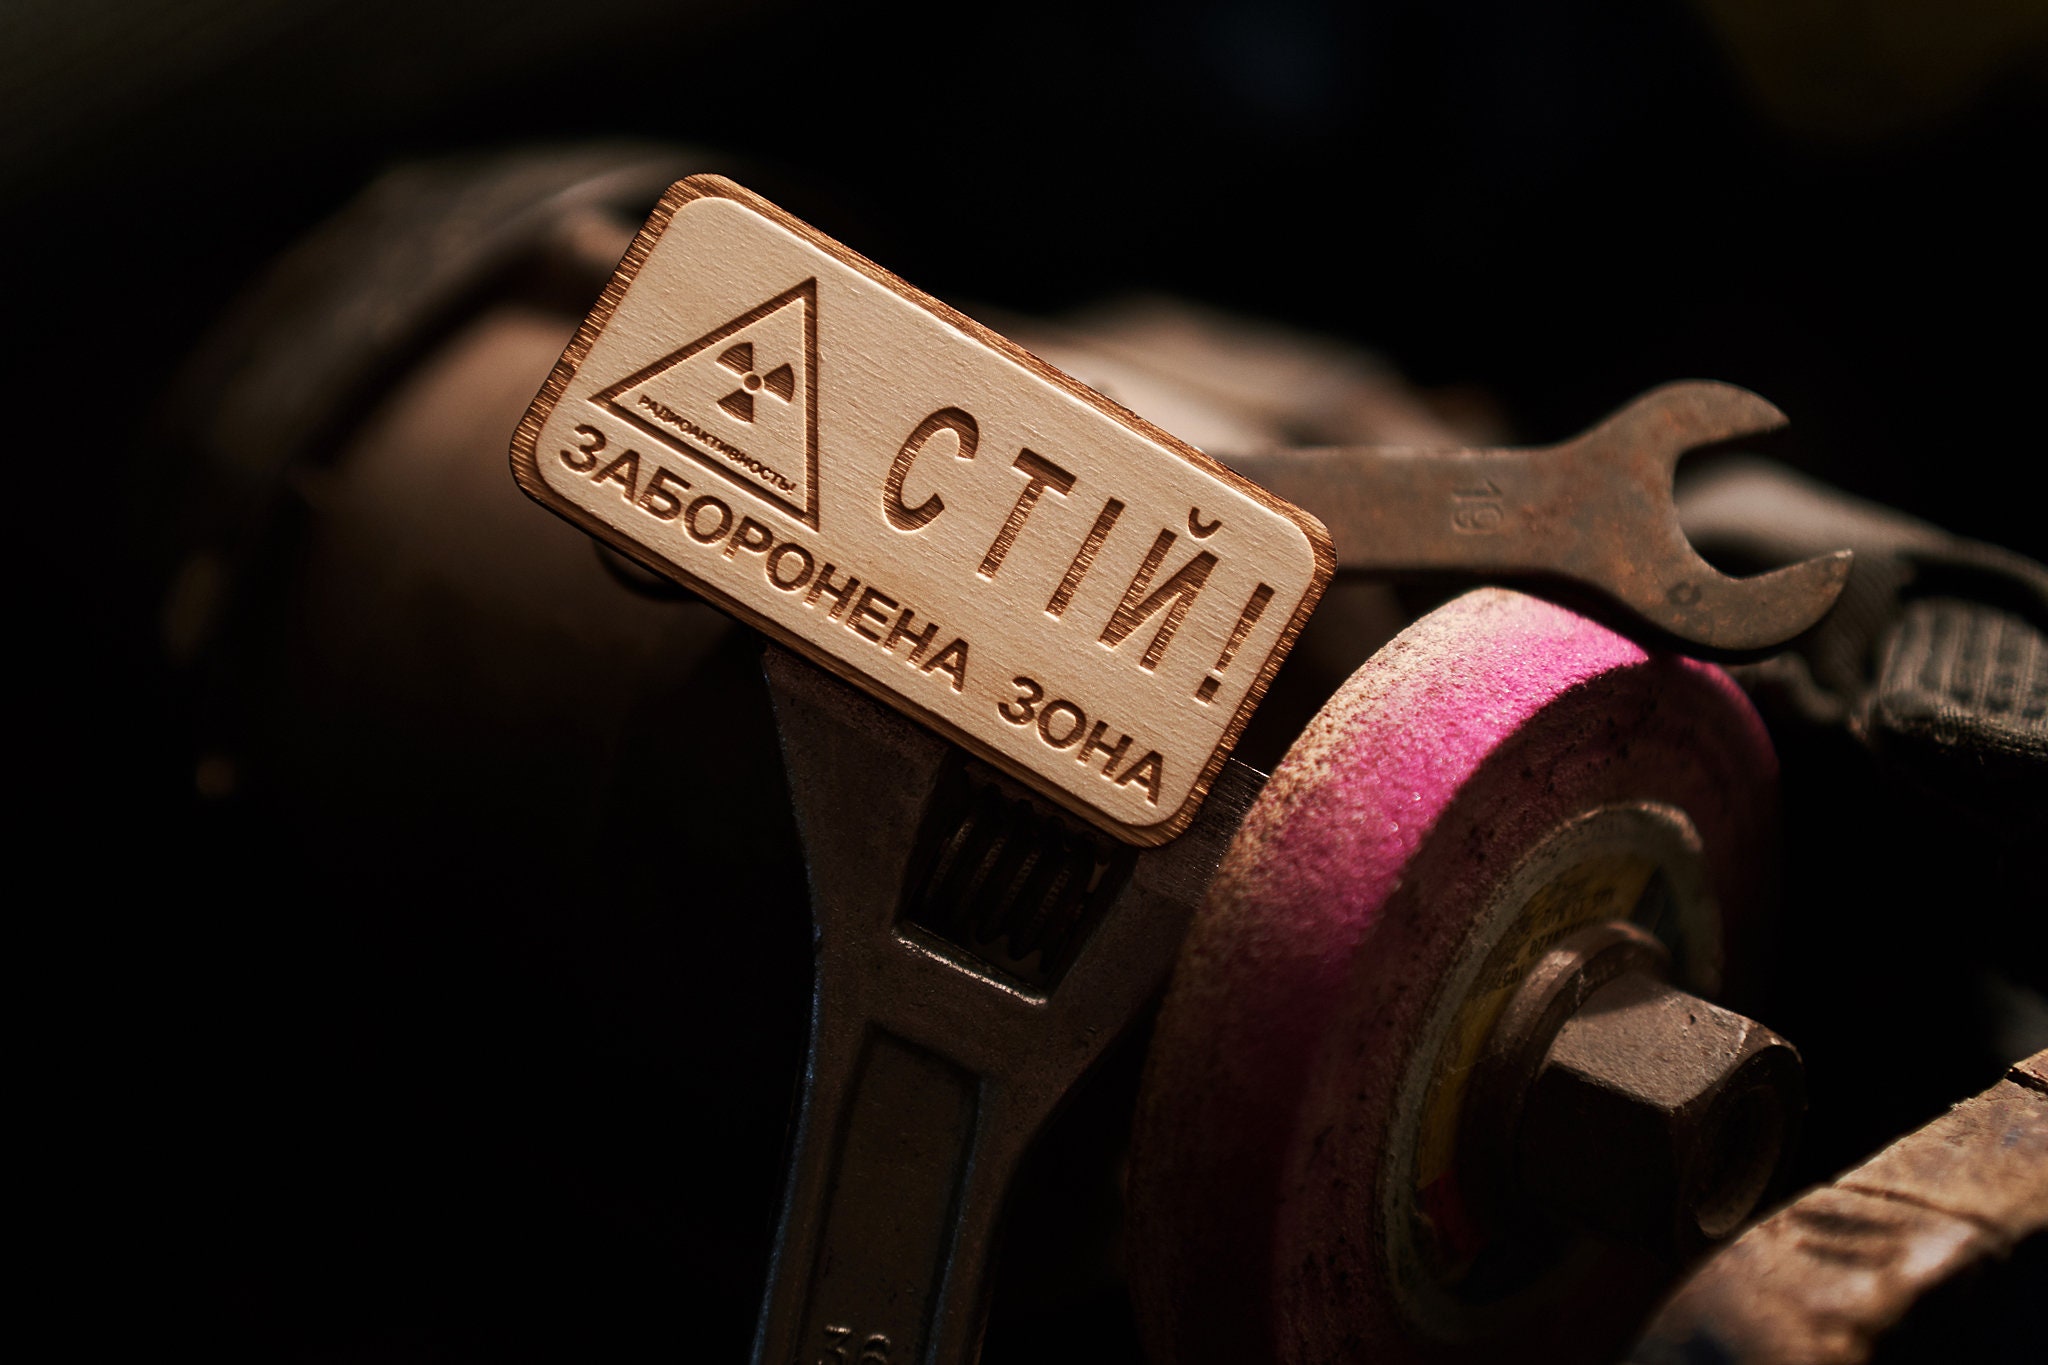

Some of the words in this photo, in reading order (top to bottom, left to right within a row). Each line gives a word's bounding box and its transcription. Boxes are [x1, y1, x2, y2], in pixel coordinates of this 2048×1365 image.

[637, 394, 797, 496] РАДИОАКТИВНОСТЬ!
[882, 407, 1275, 706] СТІЙ!
[560, 424, 969, 693] ЗАБОРОНЕНА
[997, 676, 1163, 806] ЗОНА
